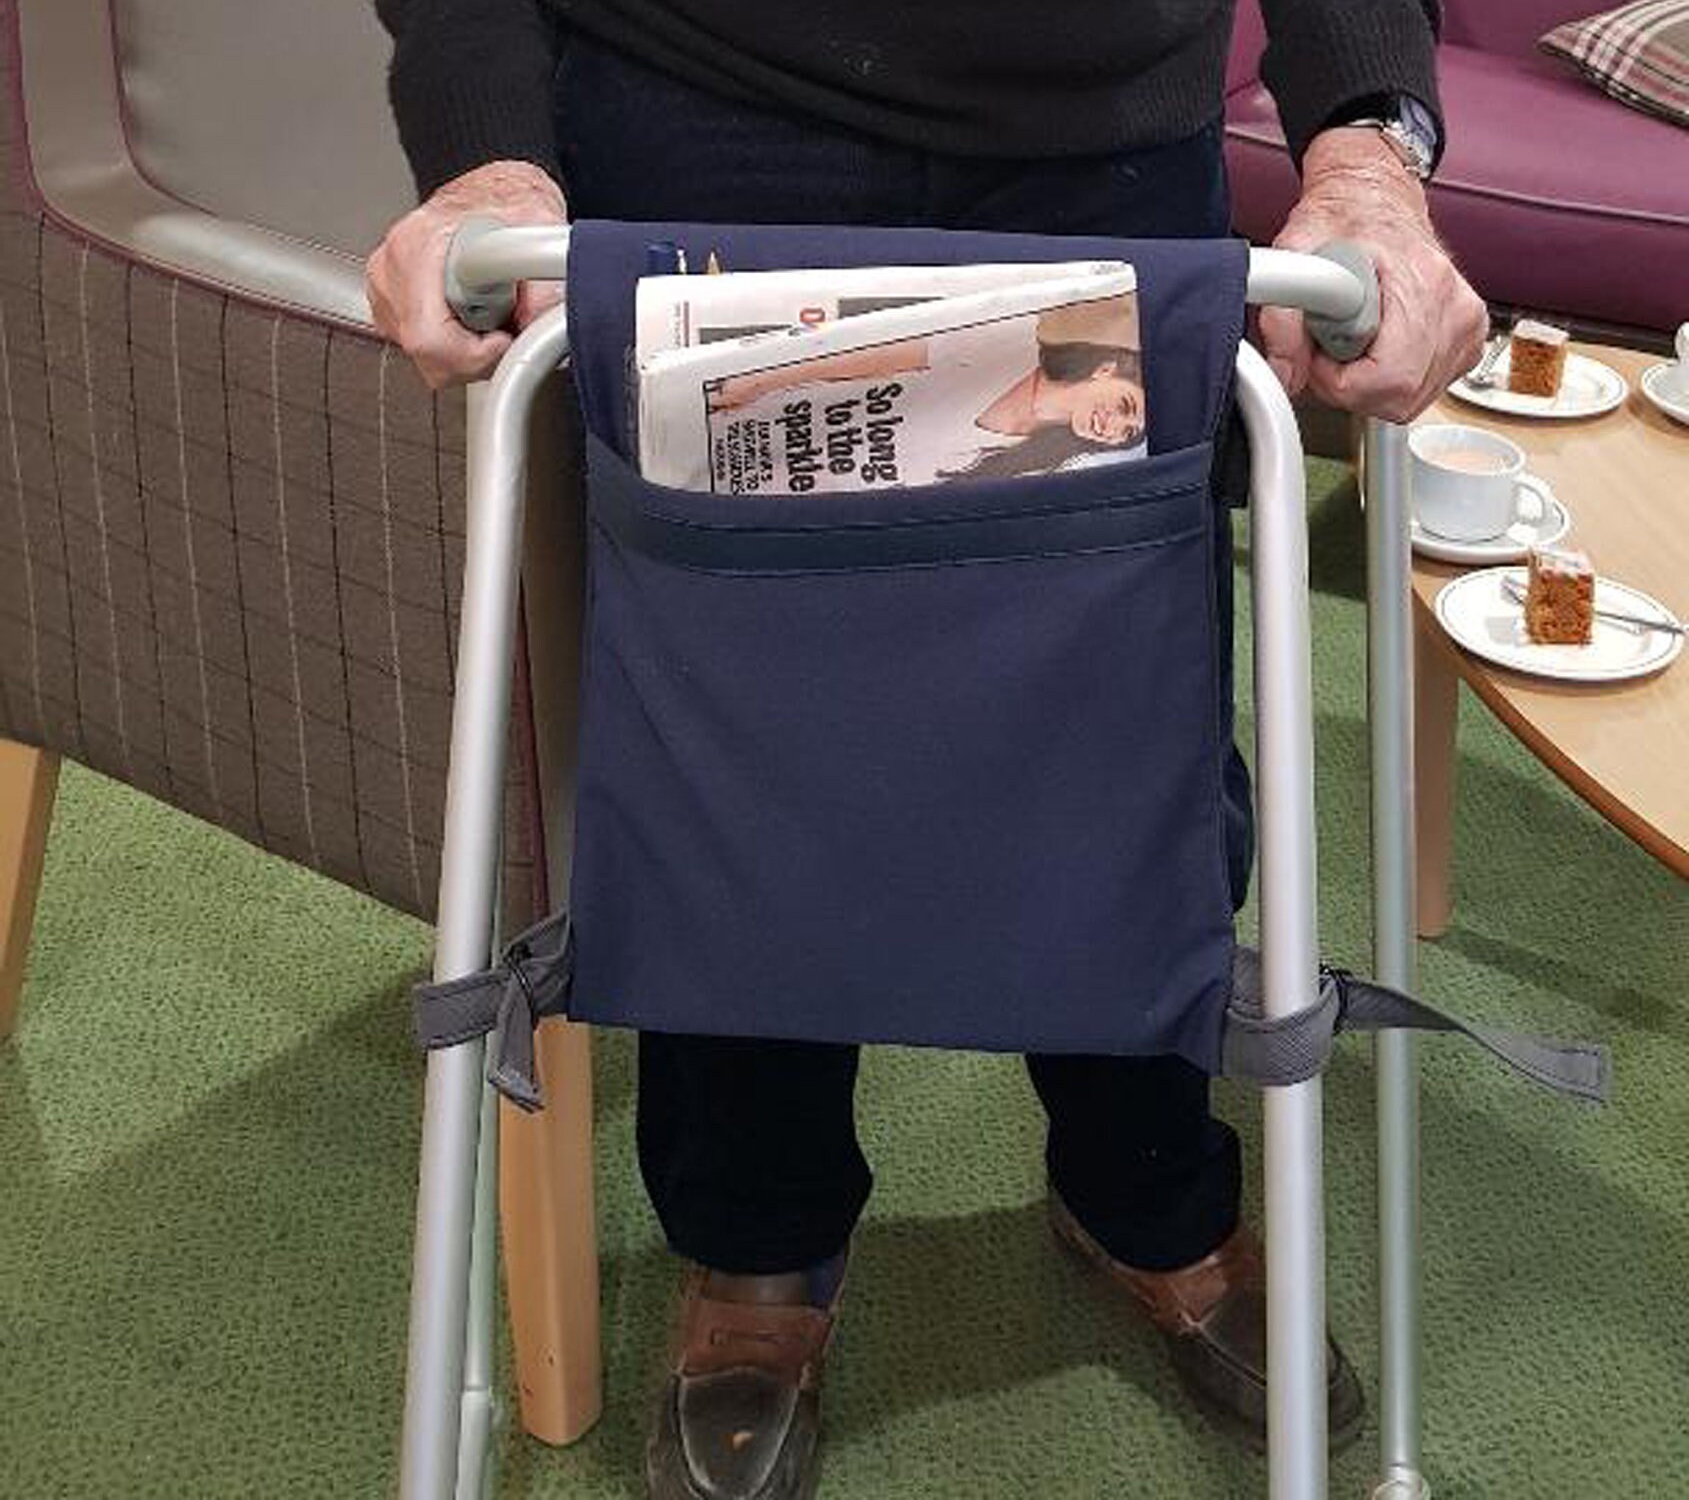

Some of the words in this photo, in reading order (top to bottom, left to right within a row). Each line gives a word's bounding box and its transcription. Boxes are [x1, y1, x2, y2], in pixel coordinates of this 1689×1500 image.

[825, 400, 861, 426] to
[866, 383, 903, 415] So
[775, 400, 824, 492] sparkle
[827, 426, 862, 474] the
[861, 416, 904, 482] long
